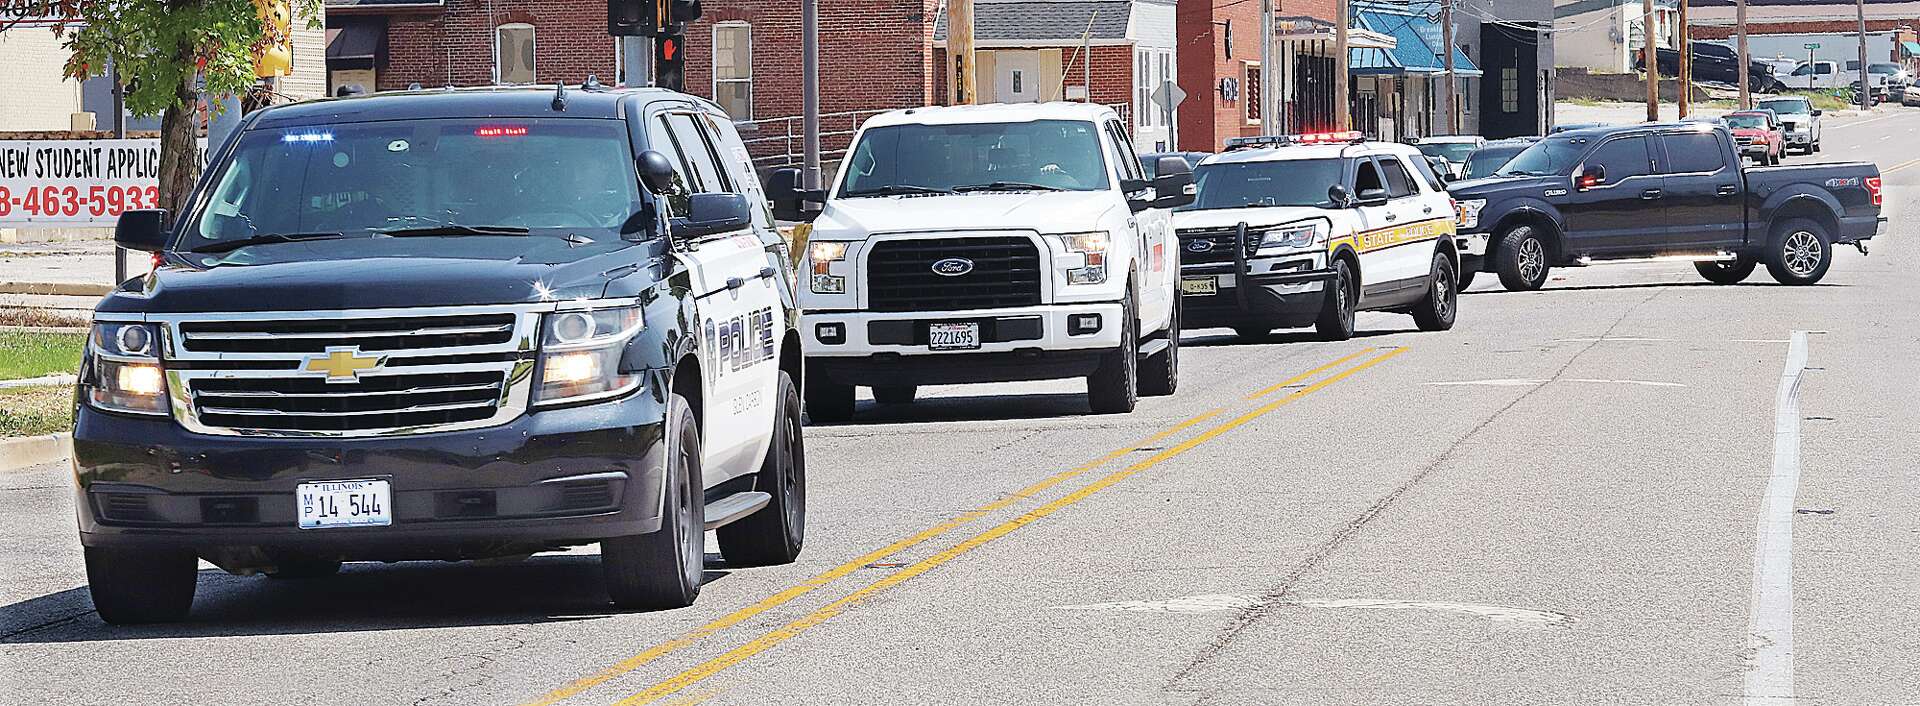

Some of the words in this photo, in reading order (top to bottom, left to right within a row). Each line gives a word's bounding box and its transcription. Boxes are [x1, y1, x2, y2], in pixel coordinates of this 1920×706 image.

[0, 147, 29, 178] NEW
[35, 147, 101, 178] STUDENT
[1363, 231, 1394, 249] STATE
[719, 305, 774, 377] POLICE
[931, 330, 973, 345] 2221695
[322, 483, 363, 491] ILLINOIS
[319, 495, 338, 517] 14
[349, 493, 381, 516] 544
